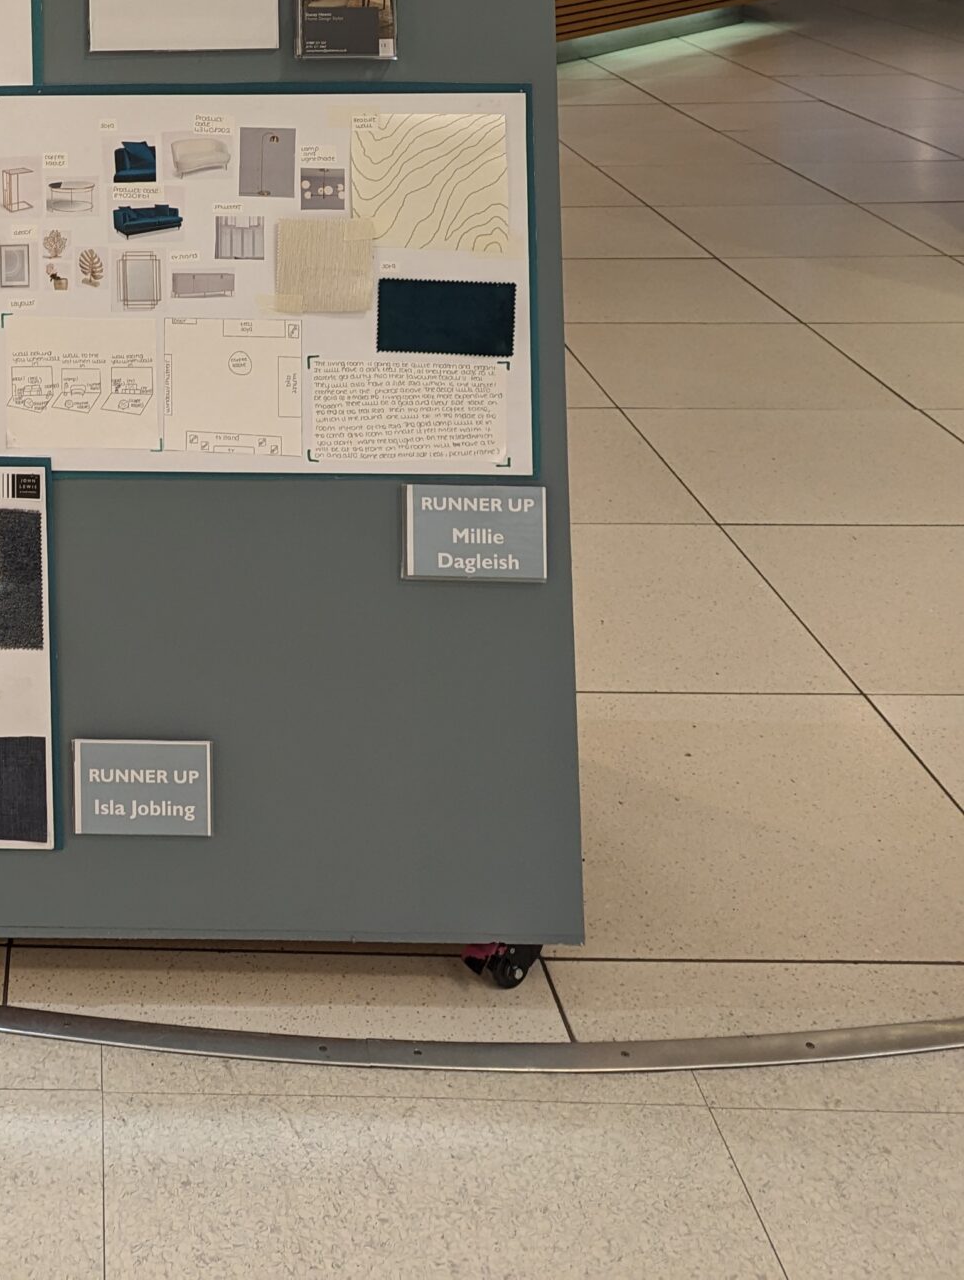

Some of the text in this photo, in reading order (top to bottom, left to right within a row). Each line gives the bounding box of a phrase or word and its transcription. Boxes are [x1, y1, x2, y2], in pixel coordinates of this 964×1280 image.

[421, 497, 535, 513] RUNNER UP
[452, 527, 504, 544] Millie
[438, 552, 520, 574] Dagleish
[89, 768, 200, 784] RUNNER UP
[94, 799, 196, 821] Isla Jobling
